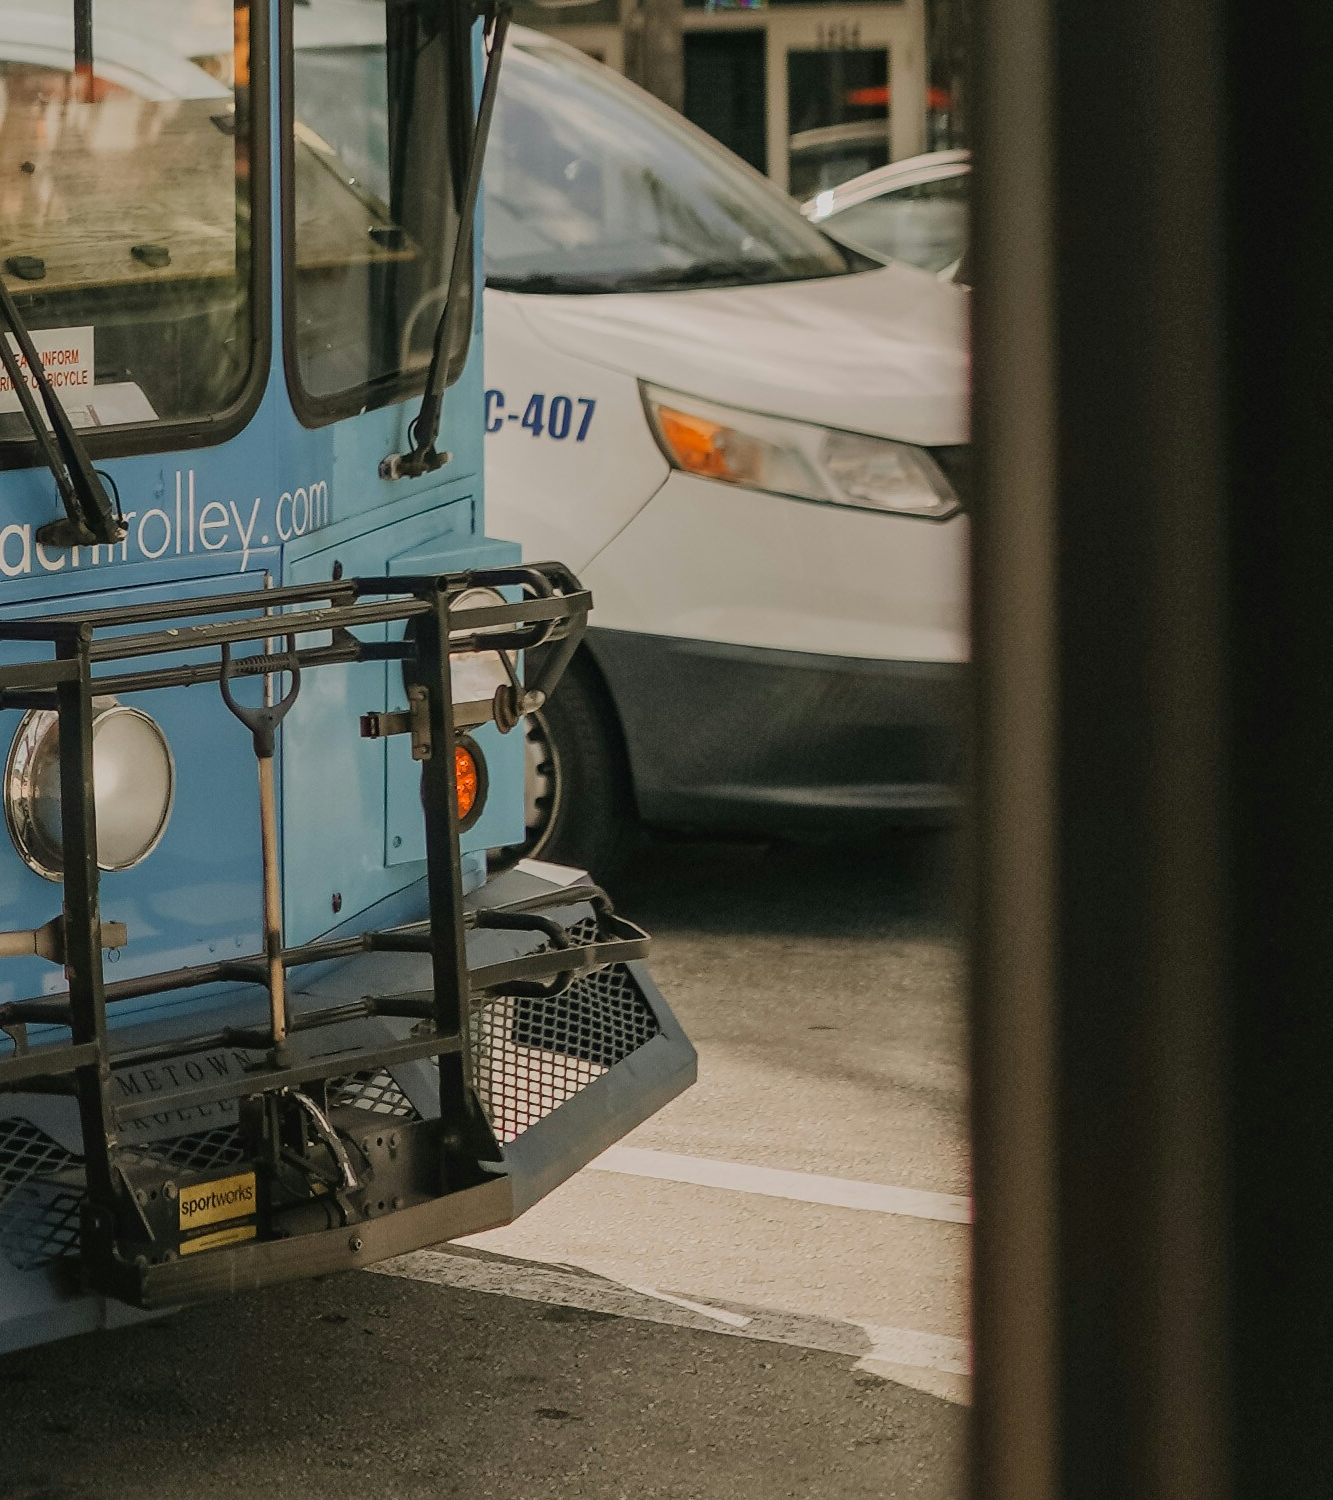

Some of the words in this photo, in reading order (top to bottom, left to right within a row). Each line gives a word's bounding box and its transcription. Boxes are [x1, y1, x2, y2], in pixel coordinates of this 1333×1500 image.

[42, 348, 79, 366] INFORM
[47, 370, 88, 389] BICYCLE
[484, 389, 596, 442] C-407
[116, 1050, 253, 1097] METOWN
[181, 1184, 253, 1217] sportworks
